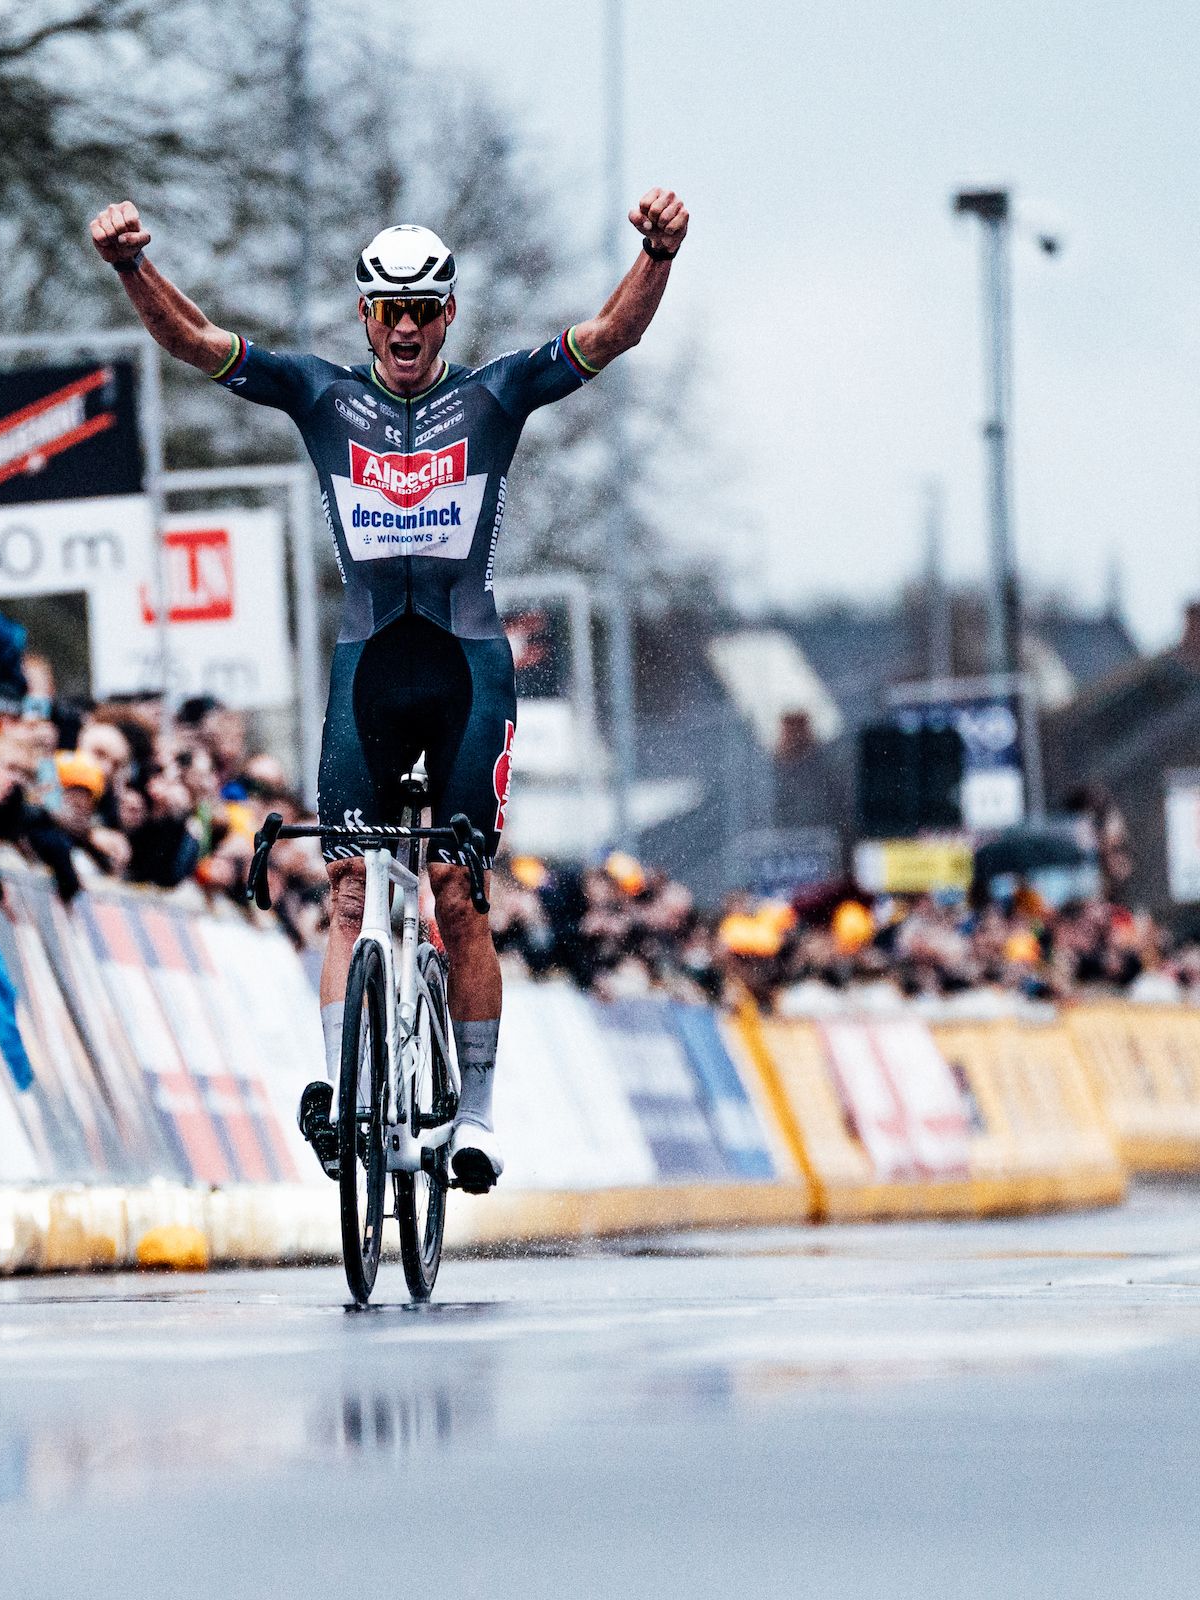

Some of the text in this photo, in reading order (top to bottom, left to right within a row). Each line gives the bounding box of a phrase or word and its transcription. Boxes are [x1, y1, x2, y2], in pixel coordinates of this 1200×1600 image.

[415, 399, 463, 430] CANYON
[362, 455, 454, 492] Alpecin
[363, 474, 454, 495] HAIR BOOSTER
[352, 501, 461, 530] deceuninck
[377, 534, 433, 543] WINDOWS
[484, 475, 507, 593] deceuninck
